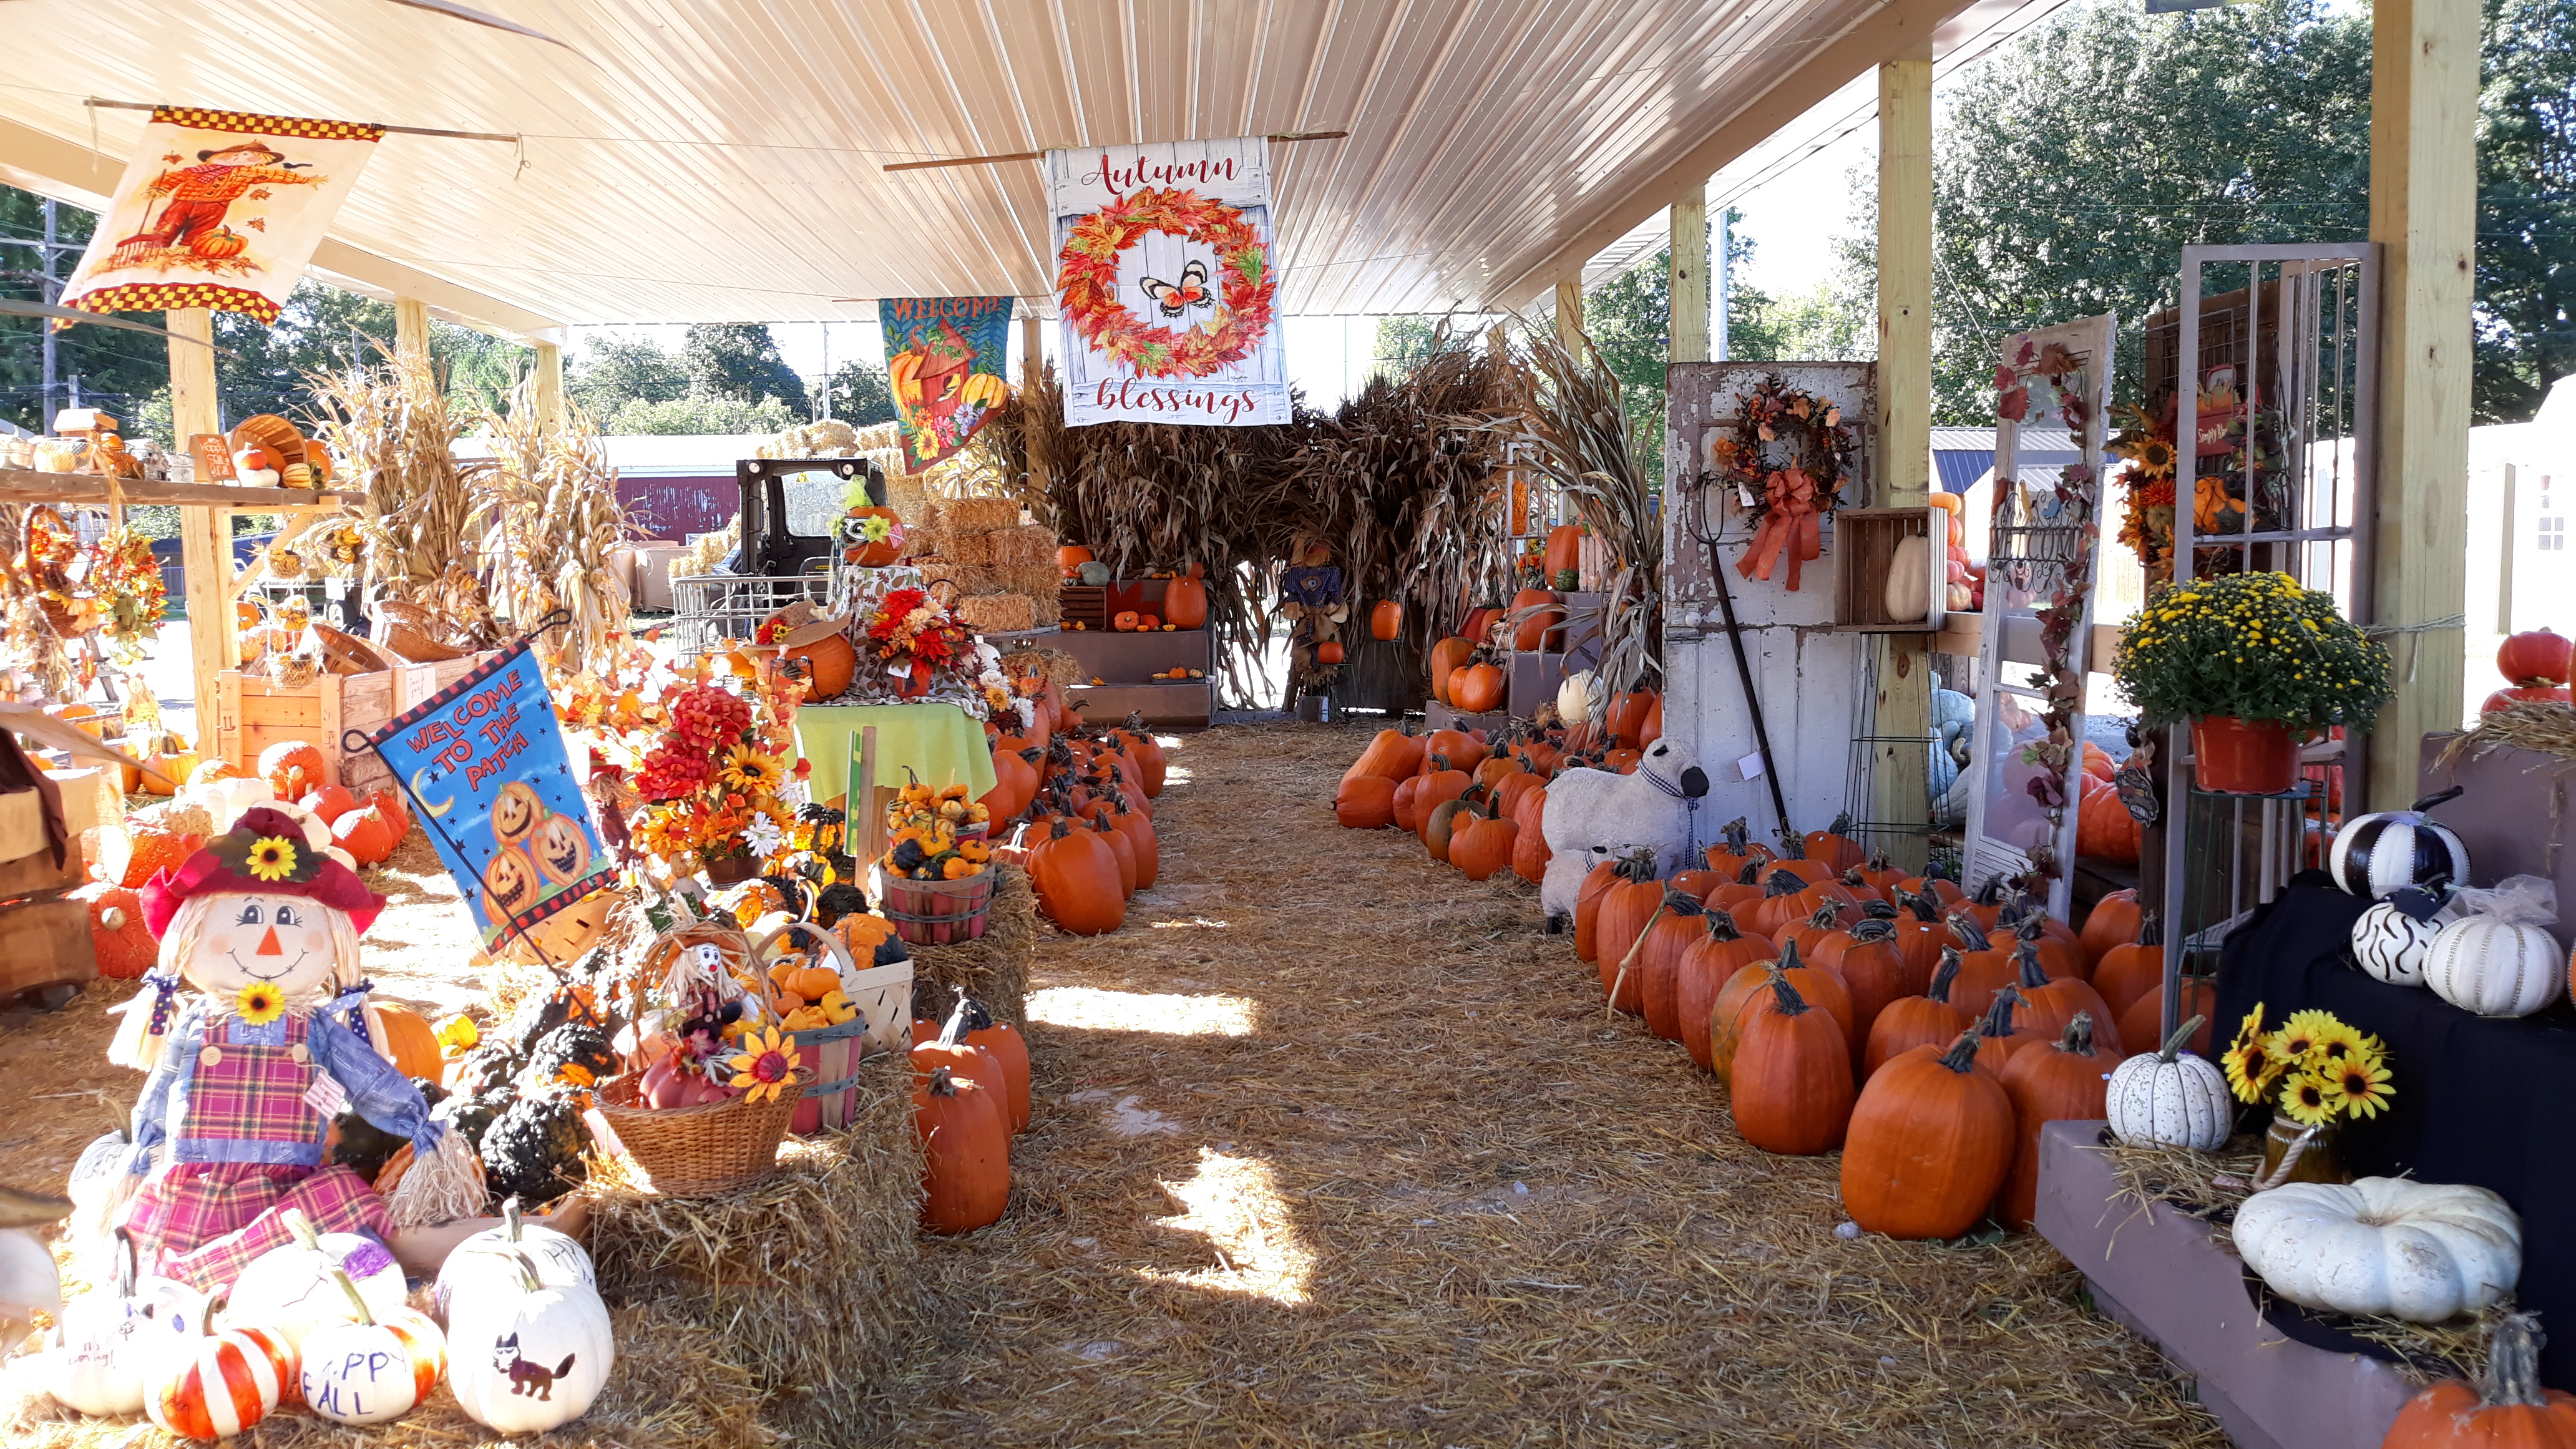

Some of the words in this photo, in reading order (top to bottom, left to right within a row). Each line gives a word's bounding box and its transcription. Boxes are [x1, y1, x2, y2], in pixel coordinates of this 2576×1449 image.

[1081, 154, 1242, 195] Autumn
[892, 296, 1004, 321] WELCOME
[1097, 377, 1261, 425] blessings
[1989, 529, 2081, 561] WELCOM
[406, 668, 523, 754] WELCOME
[432, 738, 473, 774] TO
[479, 702, 520, 746] THE
[465, 730, 529, 792] PATCH
[303, 1371, 374, 1417] FALL
